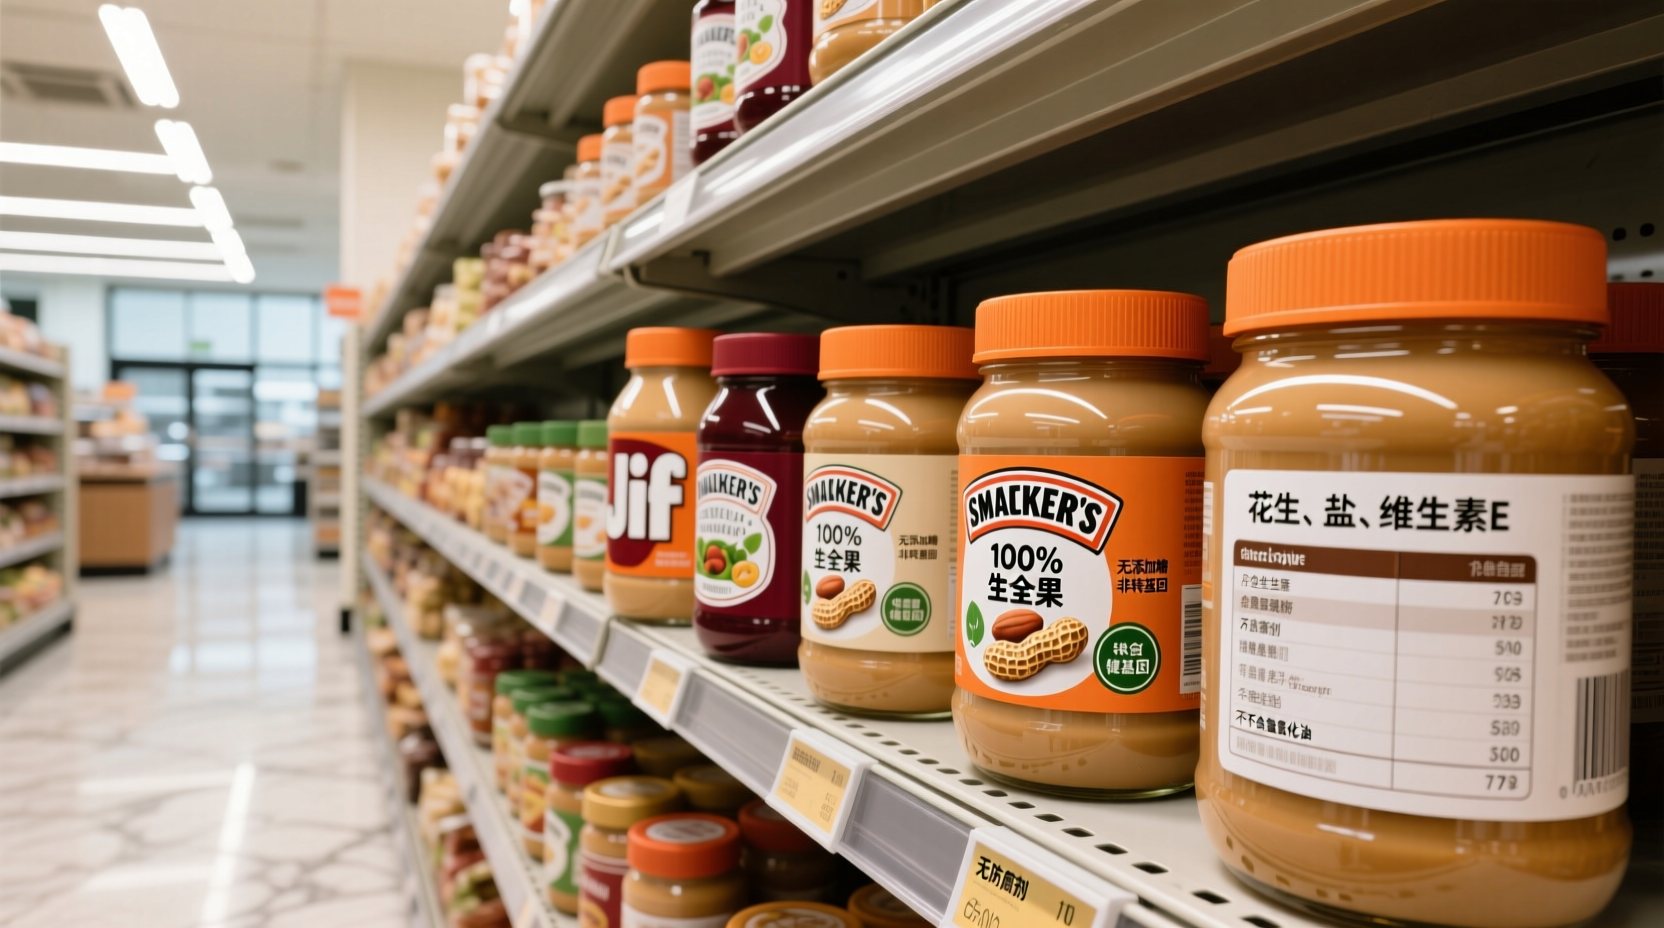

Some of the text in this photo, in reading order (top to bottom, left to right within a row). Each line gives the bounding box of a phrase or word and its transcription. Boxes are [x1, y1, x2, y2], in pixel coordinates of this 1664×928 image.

[606, 452, 687, 541] Jif
[968, 485, 1102, 534] SMACKER'S
[1248, 490, 1510, 532] 花生、盐、维生素E
[816, 523, 862, 546] 100%
[814, 548, 861, 573] 生全果
[990, 543, 1063, 574] 100%
[987, 573, 1063, 608] 生全果
